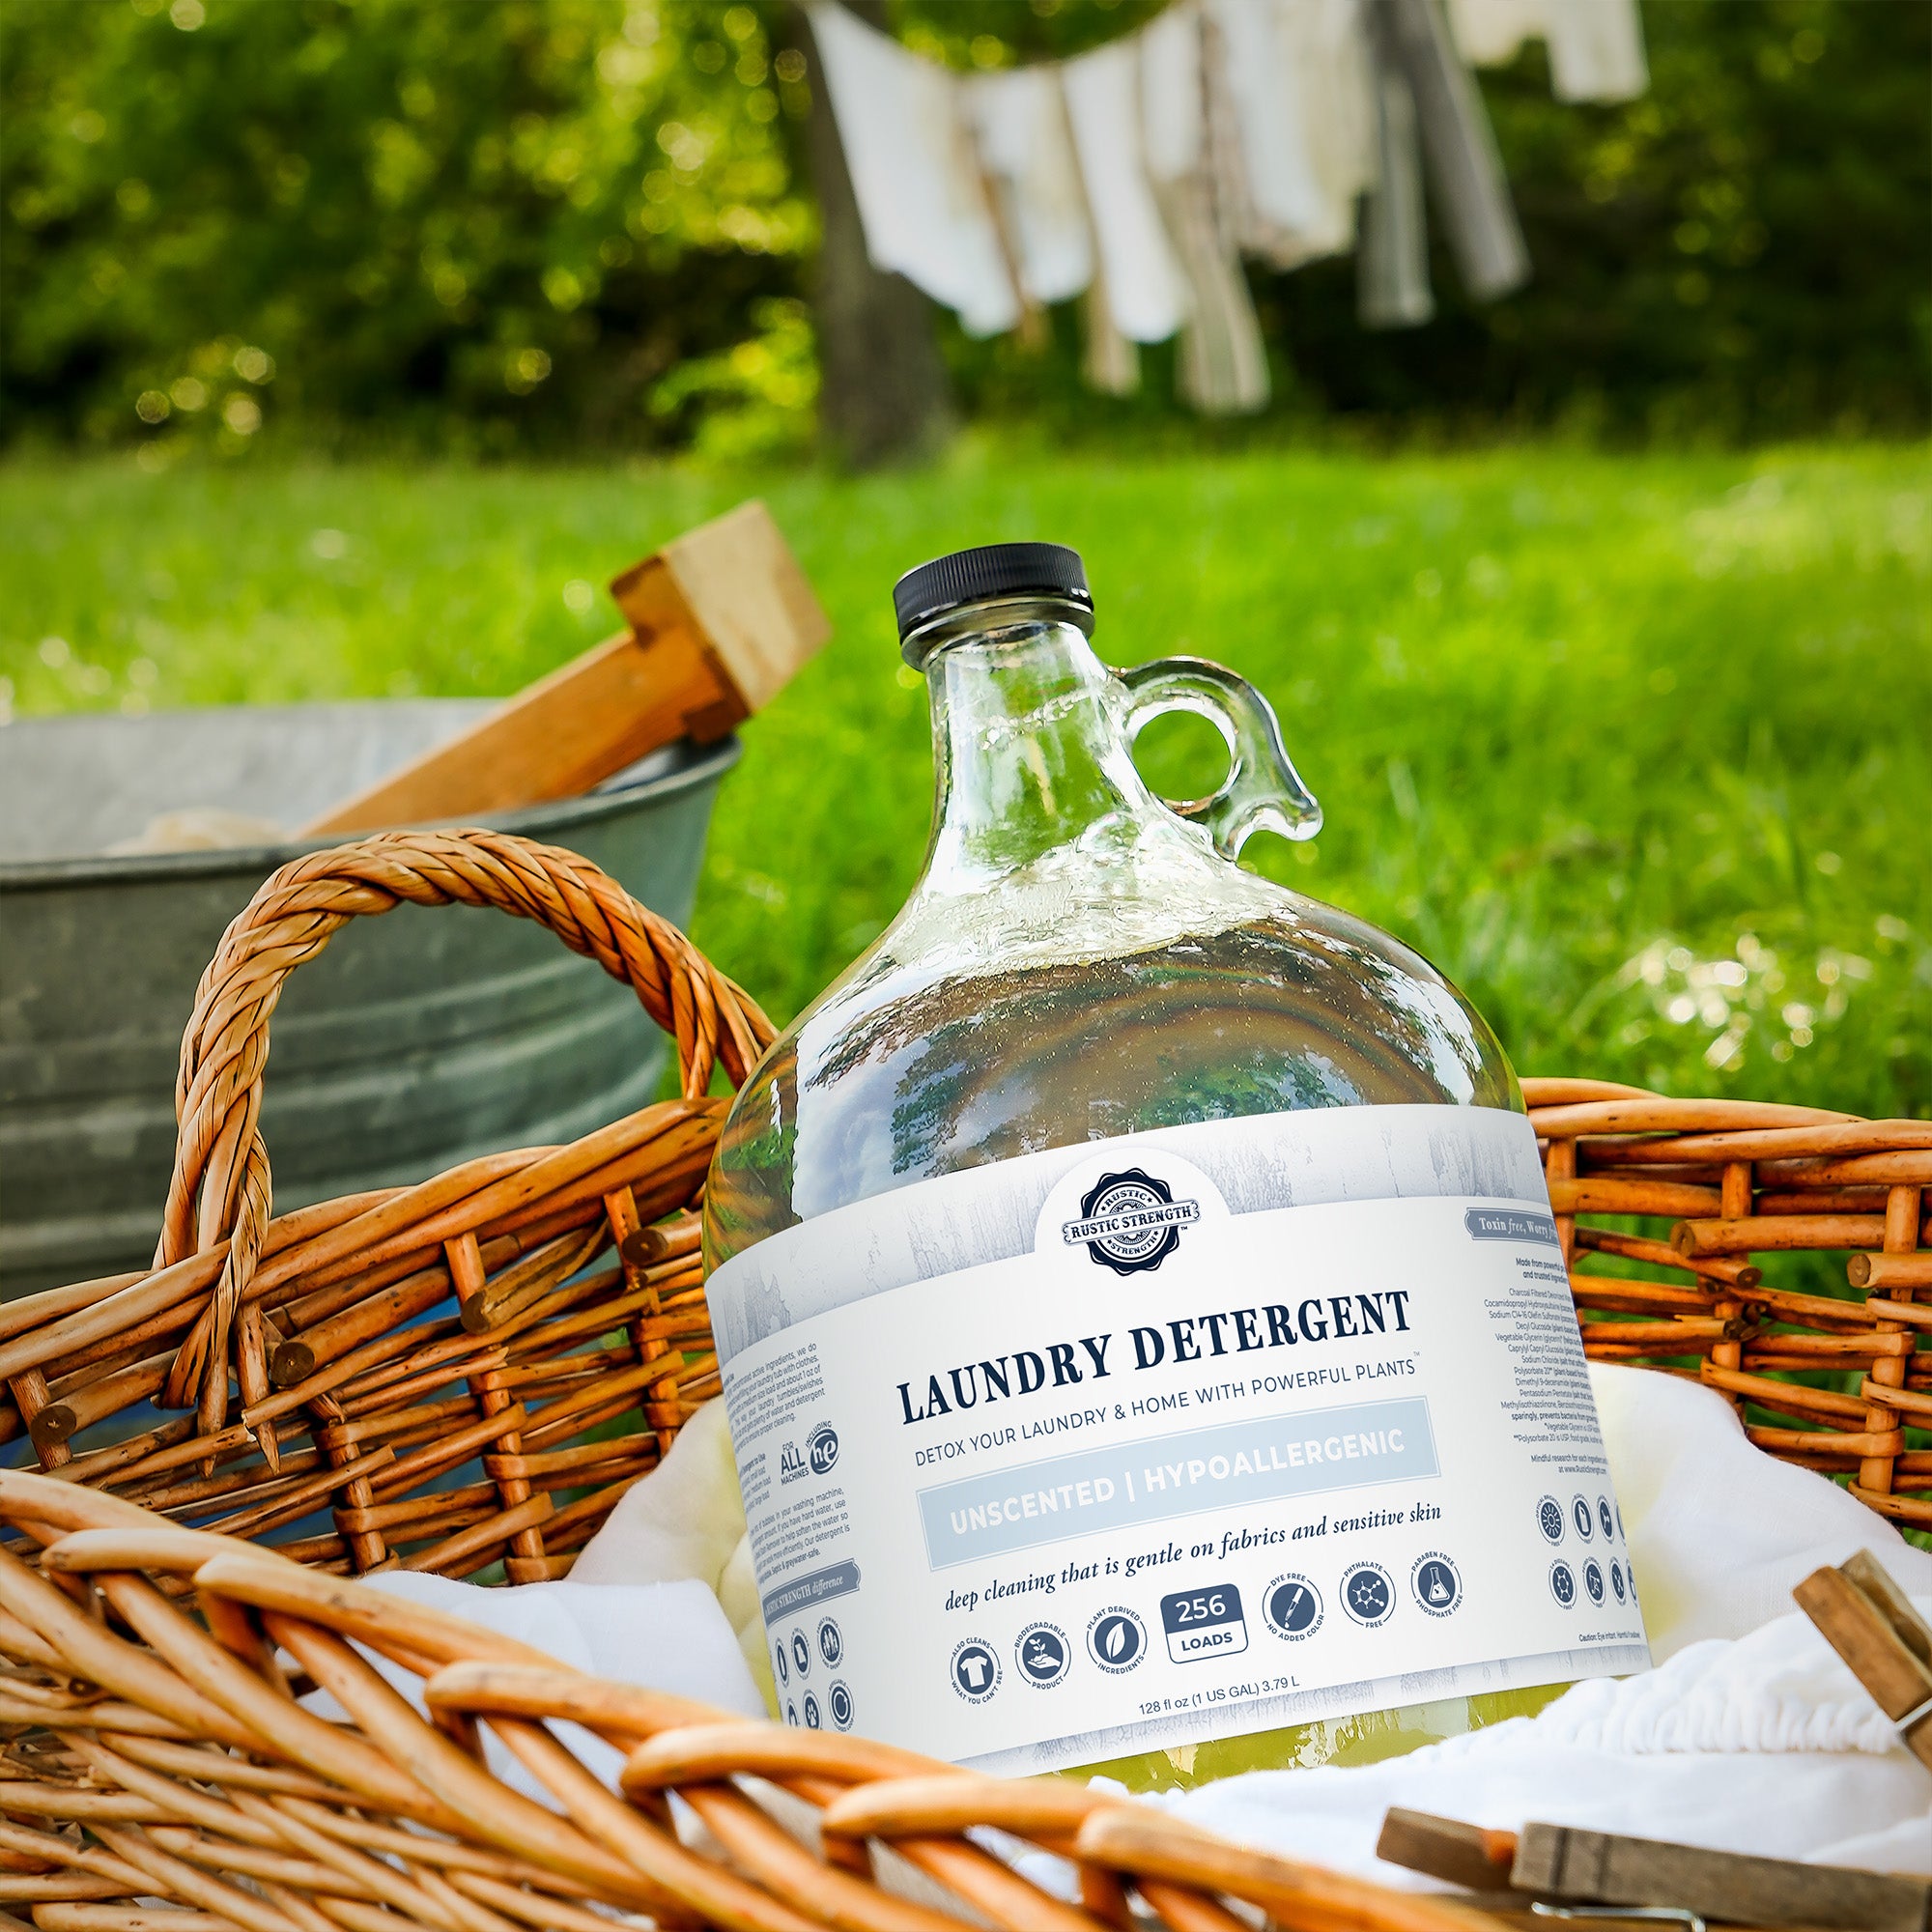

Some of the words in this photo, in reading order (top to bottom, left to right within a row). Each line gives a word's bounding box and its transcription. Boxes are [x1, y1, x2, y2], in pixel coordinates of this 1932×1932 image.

[1104, 1189, 1148, 1208] RUSTIC
[1070, 1218, 1120, 1239] RUSTIC
[1122, 1205, 1192, 1229] STRENGTH
[1479, 1217, 1506, 1230] Toxin
[1508, 1218, 1526, 1235] free,
[1526, 1221, 1548, 1238] Worry
[1110, 1236, 1157, 1255] STRENGTH
[1516, 1258, 1531, 1266] Made
[1531, 1259, 1543, 1268] from
[1523, 1270, 1534, 1279] and
[1509, 1288, 1530, 1296] Charcoal
[808, 1343, 816, 1351] do
[1495, 1333, 1522, 1342] Vegetable
[896, 1334, 1112, 1425] LAUNDRY
[1128, 1291, 1410, 1371] DETERGENT
[773, 1369, 782, 1378] tub
[782, 1363, 795, 1374] with
[776, 1378, 785, 1389] and
[786, 1373, 802, 1385] about
[814, 1364, 820, 1374] of
[1514, 1367, 1543, 1376] Polysorbate
[1516, 1378, 1539, 1386] Dimethyl
[784, 1399, 795, 1409] and
[796, 1388, 824, 1405] detergent
[915, 1439, 966, 1466] DETOX
[970, 1428, 1016, 1451] YOUR
[1021, 1407, 1106, 1439] LAUNDRY
[1114, 1404, 1126, 1420] &
[1131, 1391, 1190, 1416] HOME
[1195, 1381, 1245, 1404] WITH
[1251, 1367, 1350, 1395] POWERFUL
[1512, 1411, 1538, 1421] sparingly,
[805, 1420, 832, 1448] INCLUDING
[782, 1441, 794, 1452] FOR
[812, 1439, 837, 1464] he
[781, 1447, 806, 1475] ALL
[781, 1467, 810, 1486] MACHINES
[950, 1477, 1115, 1535] UNSCENTED
[1144, 1428, 1406, 1492] HYPOALLERGENIC
[781, 1507, 790, 1519] your
[793, 1498, 814, 1511] washing
[816, 1488, 843, 1501] machine,
[789, 1516, 801, 1525] have
[802, 1509, 814, 1520] hard
[815, 1504, 833, 1515] water,
[835, 1499, 845, 1508] use
[785, 1531, 795, 1540] help
[796, 1525, 811, 1537] soften
[811, 1521, 821, 1530] the
[822, 1515, 838, 1525] water
[840, 1512, 848, 1520] so
[805, 1537, 813, 1546] Our
[815, 1526, 843, 1542] detergent
[945, 1590, 979, 1612] deep
[984, 1573, 1056, 1601] cleaning
[1062, 1562, 1098, 1584] that
[1105, 1557, 1119, 1575] is
[1125, 1543, 1182, 1577] gentle
[1190, 1542, 1214, 1558] on
[1218, 1527, 1286, 1560] fabrics
[1292, 1516, 1327, 1541] and
[1333, 1509, 1404, 1534] sensitive
[1409, 1502, 1441, 1523] skin
[1411, 1550, 1438, 1573] PARABEN
[1438, 1552, 1455, 1568] FREE
[1344, 1561, 1383, 1577] PHTHALATE
[1269, 1575, 1285, 1587] DYE
[1286, 1573, 1307, 1582] FREE
[779, 1584, 811, 1607] STRENGTH
[812, 1577, 843, 1595] difference
[1175, 1594, 1226, 1623] 256
[1415, 1598, 1453, 1619] PHOSPHATE
[1452, 1594, 1463, 1611] FREE
[1087, 1608, 1107, 1630] PLANT
[1108, 1605, 1141, 1622] DERIVED
[1266, 1623, 1278, 1635] NO
[1278, 1632, 1305, 1642] ADDED
[1305, 1613, 1324, 1638] COLOR
[1365, 1620, 1383, 1629] FREE
[1014, 1622, 1066, 1648] BIODEGRADABLE
[1181, 1632, 1233, 1652] LOADS
[952, 1640, 965, 1658] ALSO
[966, 1636, 991, 1650] CLEANS
[1097, 1654, 1145, 1675] INGREDIENTS
[952, 1680, 967, 1701] WHAT
[968, 1695, 980, 1705] YOU
[1032, 1676, 1064, 1690] PRODUCT
[1138, 1701, 1160, 1716] 128
[1163, 1698, 1172, 1710] fl
[1175, 1697, 1189, 1708] oz
[1191, 1692, 1202, 1708] (1
[1206, 1689, 1226, 1703] US
[1229, 1683, 1260, 1698] GAL)
[1262, 1677, 1289, 1691] 3.79
[1291, 1675, 1300, 1688] L
